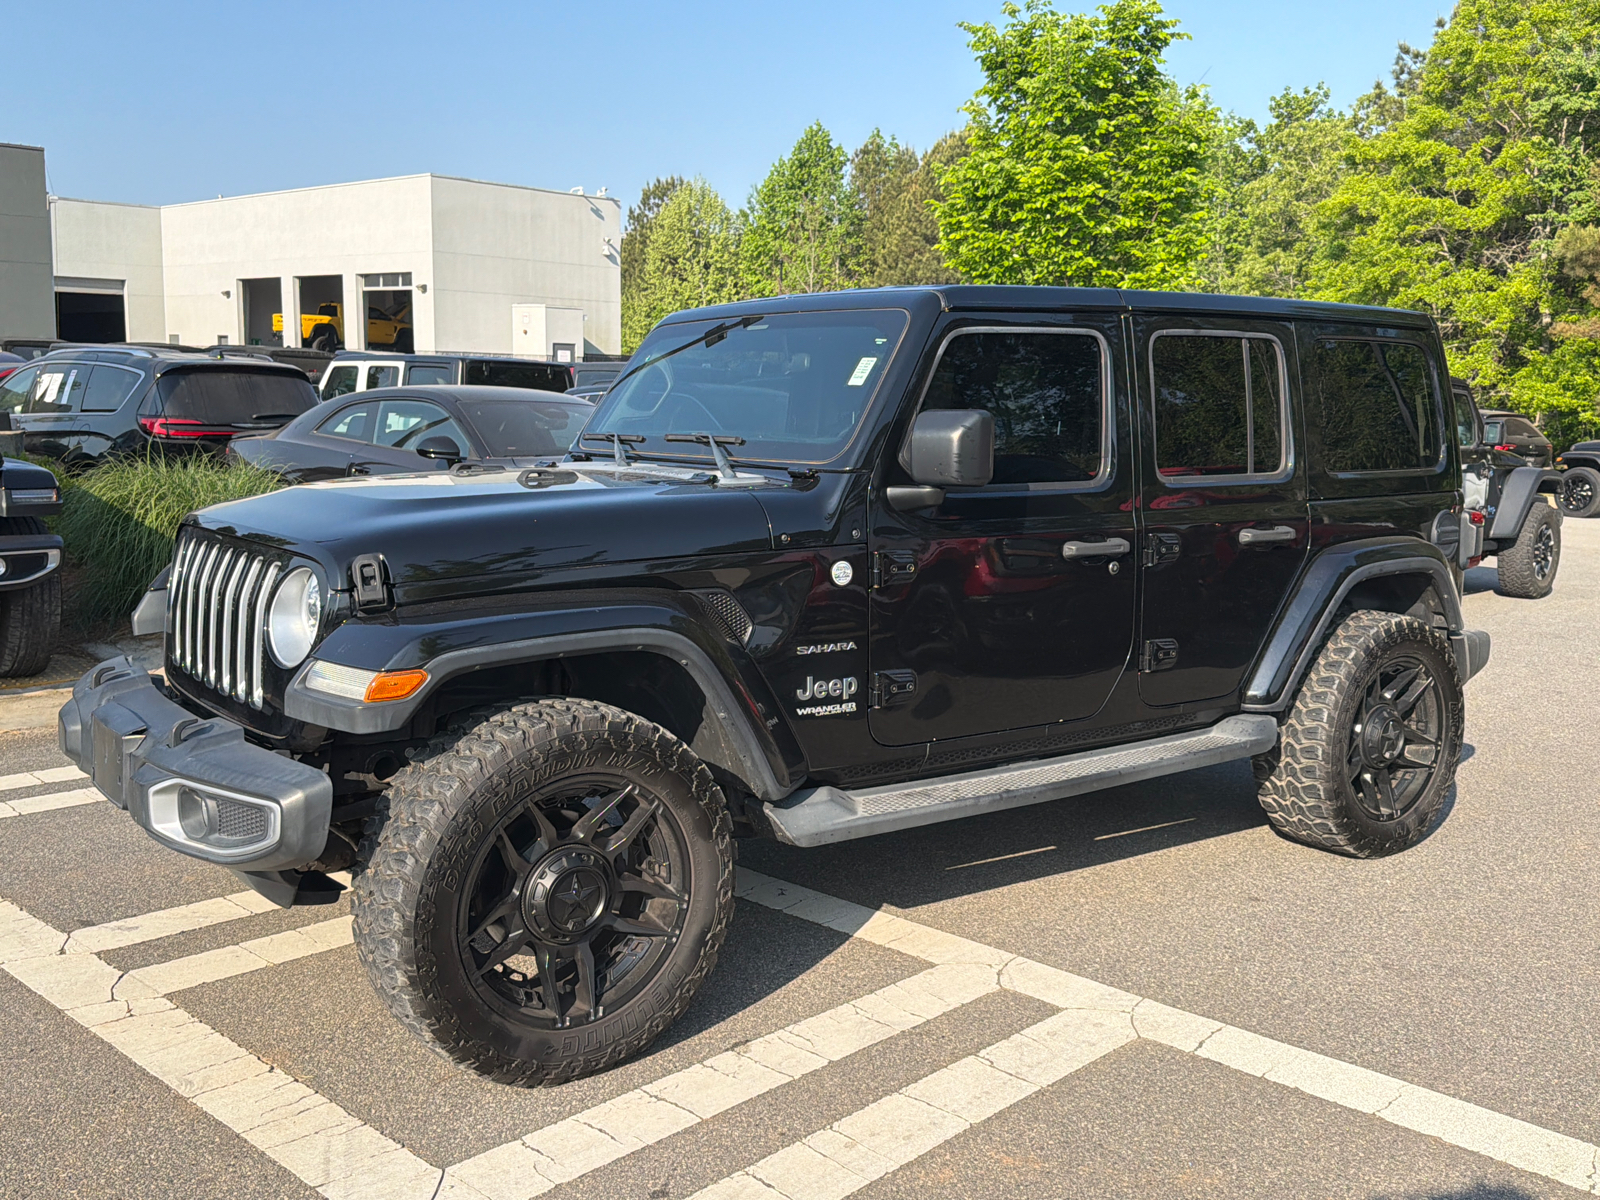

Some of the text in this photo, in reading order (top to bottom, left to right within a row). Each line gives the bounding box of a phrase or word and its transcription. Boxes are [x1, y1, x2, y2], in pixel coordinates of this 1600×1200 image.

[796, 641, 858, 656] SAHARA
[796, 675, 858, 701] Jeep
[796, 702, 857, 716] WRANGLER
[491, 750, 602, 817] BANDIT
